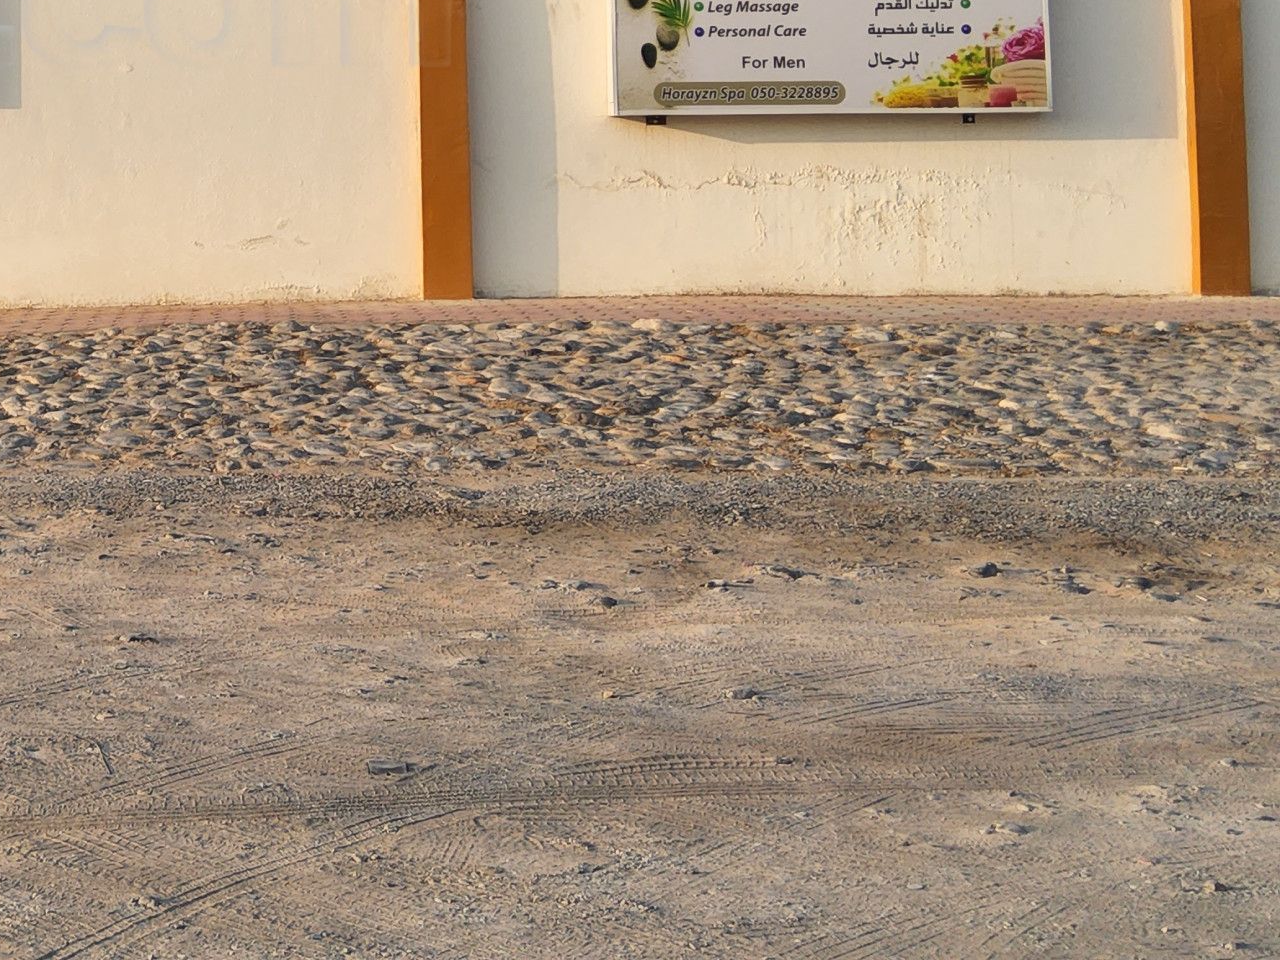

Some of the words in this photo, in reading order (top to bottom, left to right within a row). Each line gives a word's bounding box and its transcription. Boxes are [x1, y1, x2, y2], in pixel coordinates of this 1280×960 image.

[707, 1, 733, 16] Leg
[735, 0, 800, 16] Massage
[708, 24, 771, 38] Personal
[773, 24, 807, 37] Care
[867, 21, 918, 38] شخصية
[921, 21, 955, 38] عناية
[741, 55, 768, 69] For
[772, 55, 806, 69] Men
[867, 51, 920, 70] للرجال
[661, 87, 718, 103] Horayzn
[720, 87, 746, 103] Spa
[750, 86, 839, 100] 050-3228895
